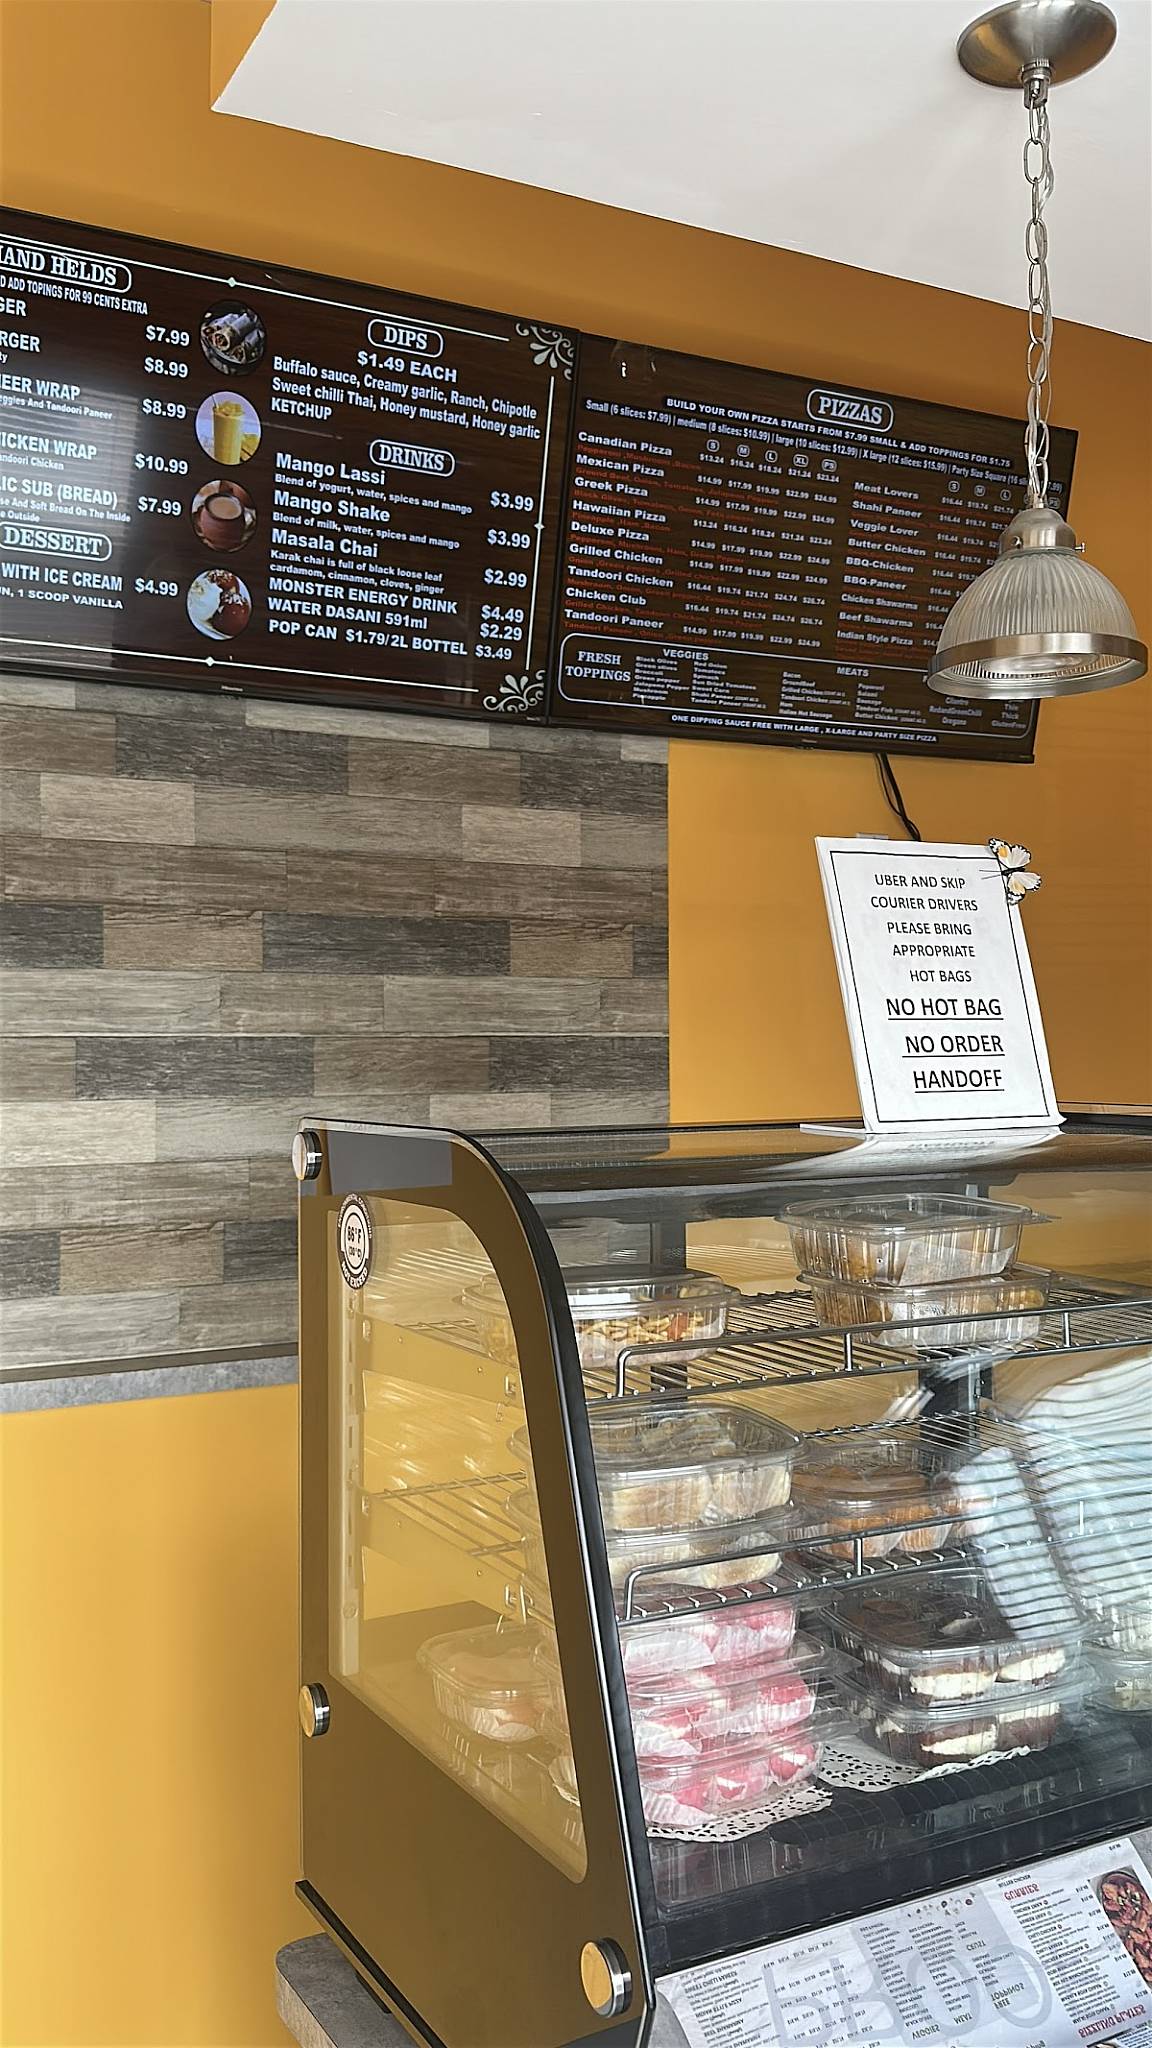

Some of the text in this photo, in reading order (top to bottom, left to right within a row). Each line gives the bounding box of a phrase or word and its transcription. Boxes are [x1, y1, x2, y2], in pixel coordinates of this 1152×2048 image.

[50, 255, 116, 286] HELDS
[7, 276, 148, 315] ADD TOPINGS FOR 99 CENTS EXTRA
[146, 325, 190, 346] $7.99
[384, 326, 427, 350] DIPS
[144, 357, 188, 378] $8.99
[357, 350, 457, 383] $1.49 EACH
[34, 379, 80, 401] WRAP
[274, 356, 537, 419] Buffalo sauce, Creamy garlic, Ranch, Chipotle
[142, 398, 186, 419] $8.99
[271, 397, 332, 420] KETCHUP
[272, 376, 540, 439] Sweet chilli Thai, Honey mustard, Honey garlic
[818, 396, 882, 424] PIZZAS
[666, 398, 696, 410] BUILD
[698, 404, 725, 416] YOUR
[727, 410, 750, 420] OWN
[752, 414, 778, 426] PIZZA
[780, 419, 816, 432] STARTS
[817, 426, 842, 437] FROM
[844, 431, 868, 442] $7.99
[869, 436, 898, 448] SMALL
[908, 443, 926, 452] ADD
[928, 446, 970, 460] TOPPINGS
[970, 454, 988, 464] FOR
[50, 440, 97, 460] WRAP
[578, 432, 672, 456] Canadian Pizza
[134, 453, 188, 474] $10.99
[379, 444, 444, 471] DRINKS
[576, 454, 629, 471] Mexican
[633, 463, 664, 477] Pizza
[276, 452, 385, 485] Mango Lassi
[21, 478, 118, 510] SUB (BREAD)
[275, 473, 472, 515] Blend of yogurt, water, spices and mango
[574, 476, 648, 496] Greek Pizza
[138, 496, 182, 516] $7.99
[274, 490, 390, 522] Mango Shake
[490, 491, 534, 512] $3.99
[573, 500, 631, 517] Hawaiian
[634, 509, 666, 522] Pizza
[4, 526, 102, 556] DESSERT
[272, 512, 460, 550] Blend of milk, water, spices and mango
[487, 529, 530, 549] $3.99
[571, 521, 614, 536] Deluxe
[618, 528, 649, 541] Pizza
[272, 528, 378, 558] Masala Chai
[569, 543, 611, 558] Grilled
[614, 550, 663, 565] Chicken
[270, 549, 443, 582] Karak chai is full of black loose leaf
[1, 562, 122, 591] WITH ICE CREAM
[135, 578, 178, 596] $4.99
[270, 564, 444, 595] cardamom, cinnamon, cloves, ginger
[484, 568, 527, 588] $2.99
[568, 565, 622, 581] Tandoori
[625, 573, 674, 588] Chicken
[18, 589, 123, 609] 1 SCOOP VANILLA
[269, 577, 458, 614] MONSTER ENERGY DRINK
[566, 587, 646, 605] Chicken Club
[268, 597, 427, 629] WATER DASANI 591ml
[481, 604, 524, 623] $4.49
[564, 608, 618, 624] Tandoori
[622, 616, 664, 628] Paneer
[269, 619, 300, 635] POP
[305, 624, 337, 640] CAN
[412, 637, 468, 655] BOTTEL
[480, 622, 522, 641] $2.29
[475, 644, 512, 660] $3.49
[578, 651, 622, 665] FRESH
[663, 648, 709, 661] VEGGIES
[565, 665, 631, 682] TOPPINGS
[874, 874, 966, 889] UBER AND SKIP
[870, 896, 978, 911] COURIER DRIVERS
[887, 922, 972, 935] PLEASE BRING
[893, 944, 976, 957] APPROPRIATE
[909, 970, 972, 982] HOT BAGS
[886, 998, 1002, 1016] NO HOT BAG
[905, 1035, 1004, 1054] NO ORDER
[913, 1069, 1002, 1088] HANDOFF
